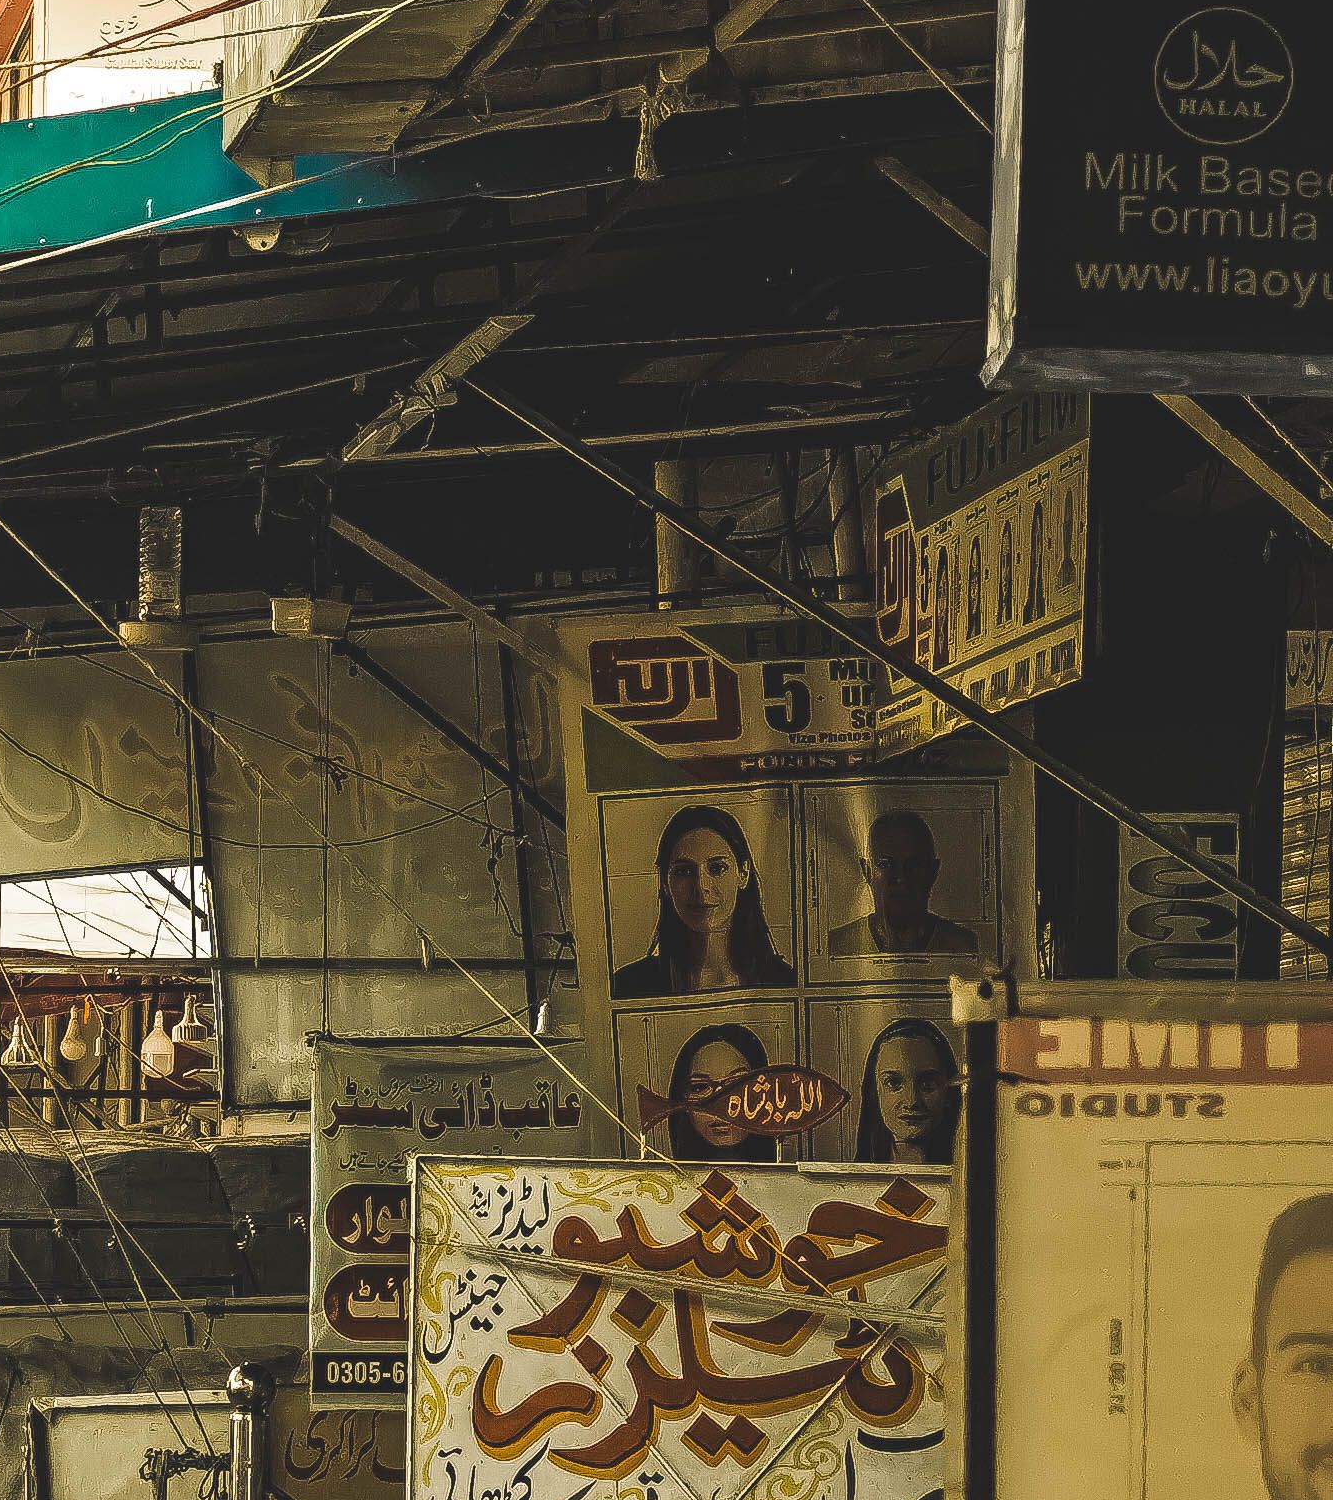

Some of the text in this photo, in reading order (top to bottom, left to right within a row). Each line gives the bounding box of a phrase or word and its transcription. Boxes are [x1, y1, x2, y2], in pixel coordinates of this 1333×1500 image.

[1163, 30, 1285, 93] حلال
[1178, 97, 1268, 119] HALAL
[1084, 152, 1333, 199] Milk Base
[1118, 196, 1319, 242] Formula
[762, 661, 813, 734] 5
[499, 1079, 584, 1143] عاقب
[507, 1169, 949, 1356] خوشبو
